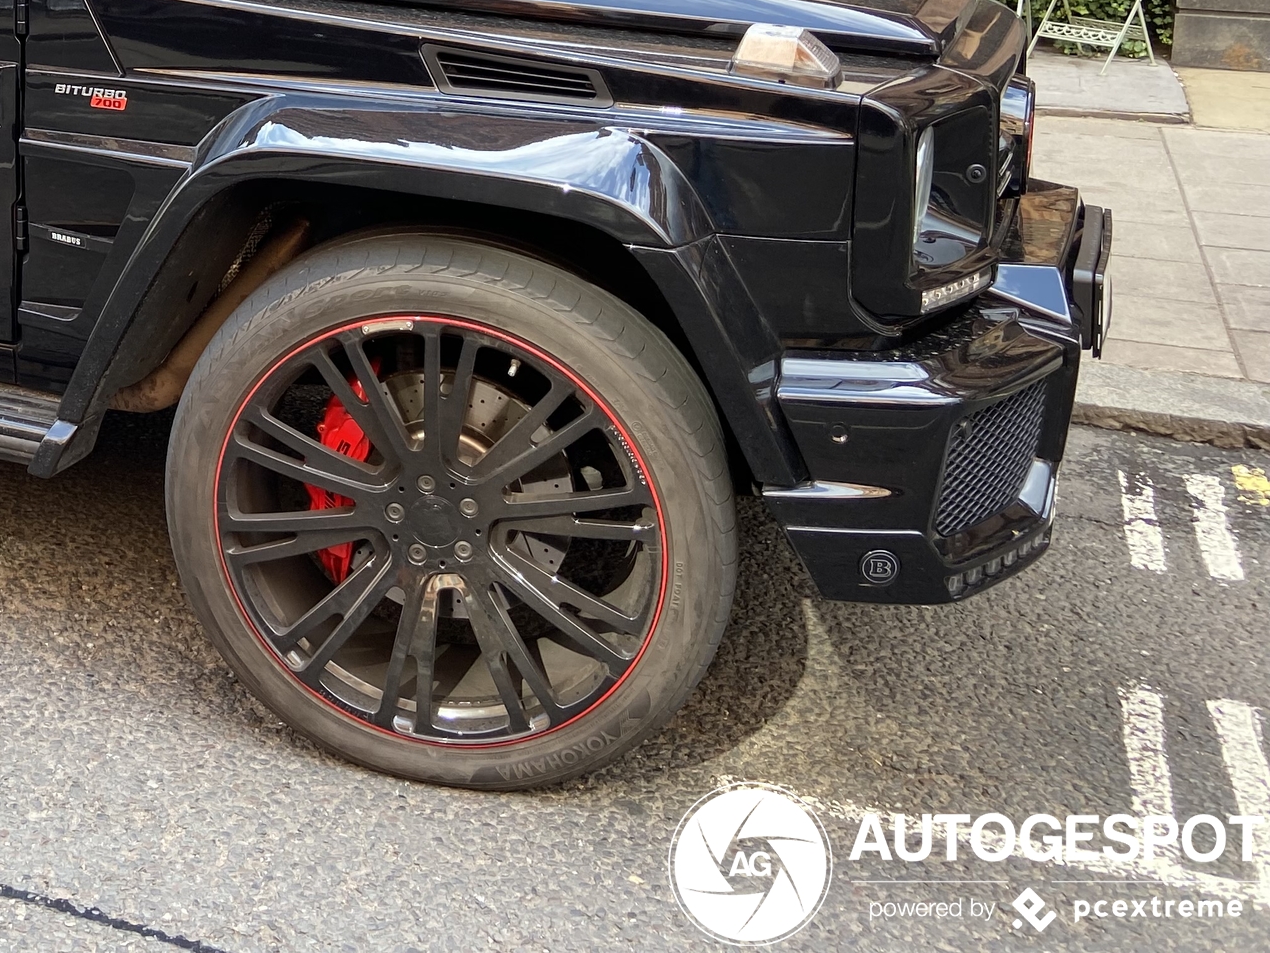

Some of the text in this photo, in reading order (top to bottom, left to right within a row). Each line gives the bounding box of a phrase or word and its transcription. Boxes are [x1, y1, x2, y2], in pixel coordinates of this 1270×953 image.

[55, 83, 127, 99] BITURBO
[94, 98, 122, 109] 700
[51, 232, 82, 246] BRABUS
[870, 559, 891, 578] B
[495, 730, 618, 781] YOKOHAMA
